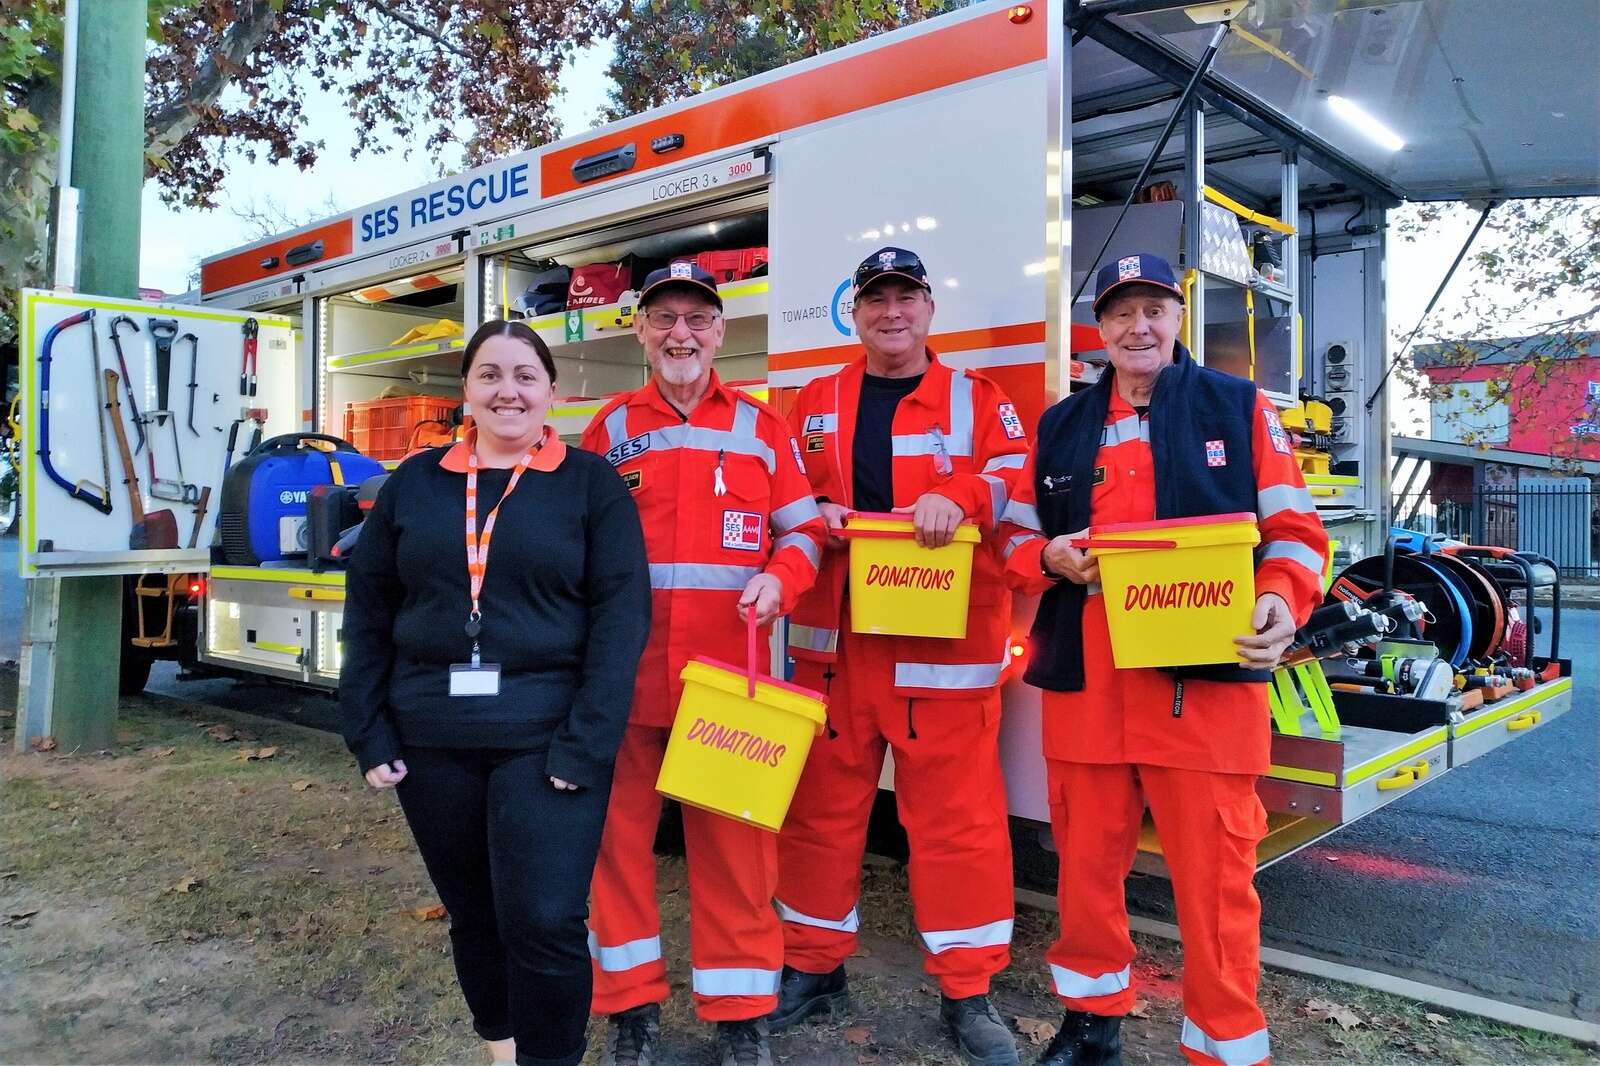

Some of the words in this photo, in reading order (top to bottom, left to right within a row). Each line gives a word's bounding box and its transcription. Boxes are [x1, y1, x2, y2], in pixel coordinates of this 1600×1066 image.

[652, 177, 698, 200] LOCKER
[702, 174, 709, 187] 3
[728, 161, 752, 177] 3000
[361, 205, 399, 242] SES
[410, 163, 529, 228] RESCUE
[389, 251, 418, 269] LOCKER
[1119, 263, 1140, 272] SES
[782, 305, 828, 323] TOWARDS
[840, 301, 853, 315] ZE
[1003, 416, 1019, 425] SE
[610, 439, 642, 462] SES
[1208, 449, 1224, 457] SES
[725, 523, 741, 532] SES
[866, 563, 954, 592] DONATIONS
[1124, 580, 1233, 611] DONATIONS
[687, 717, 787, 768] DONATIONS
